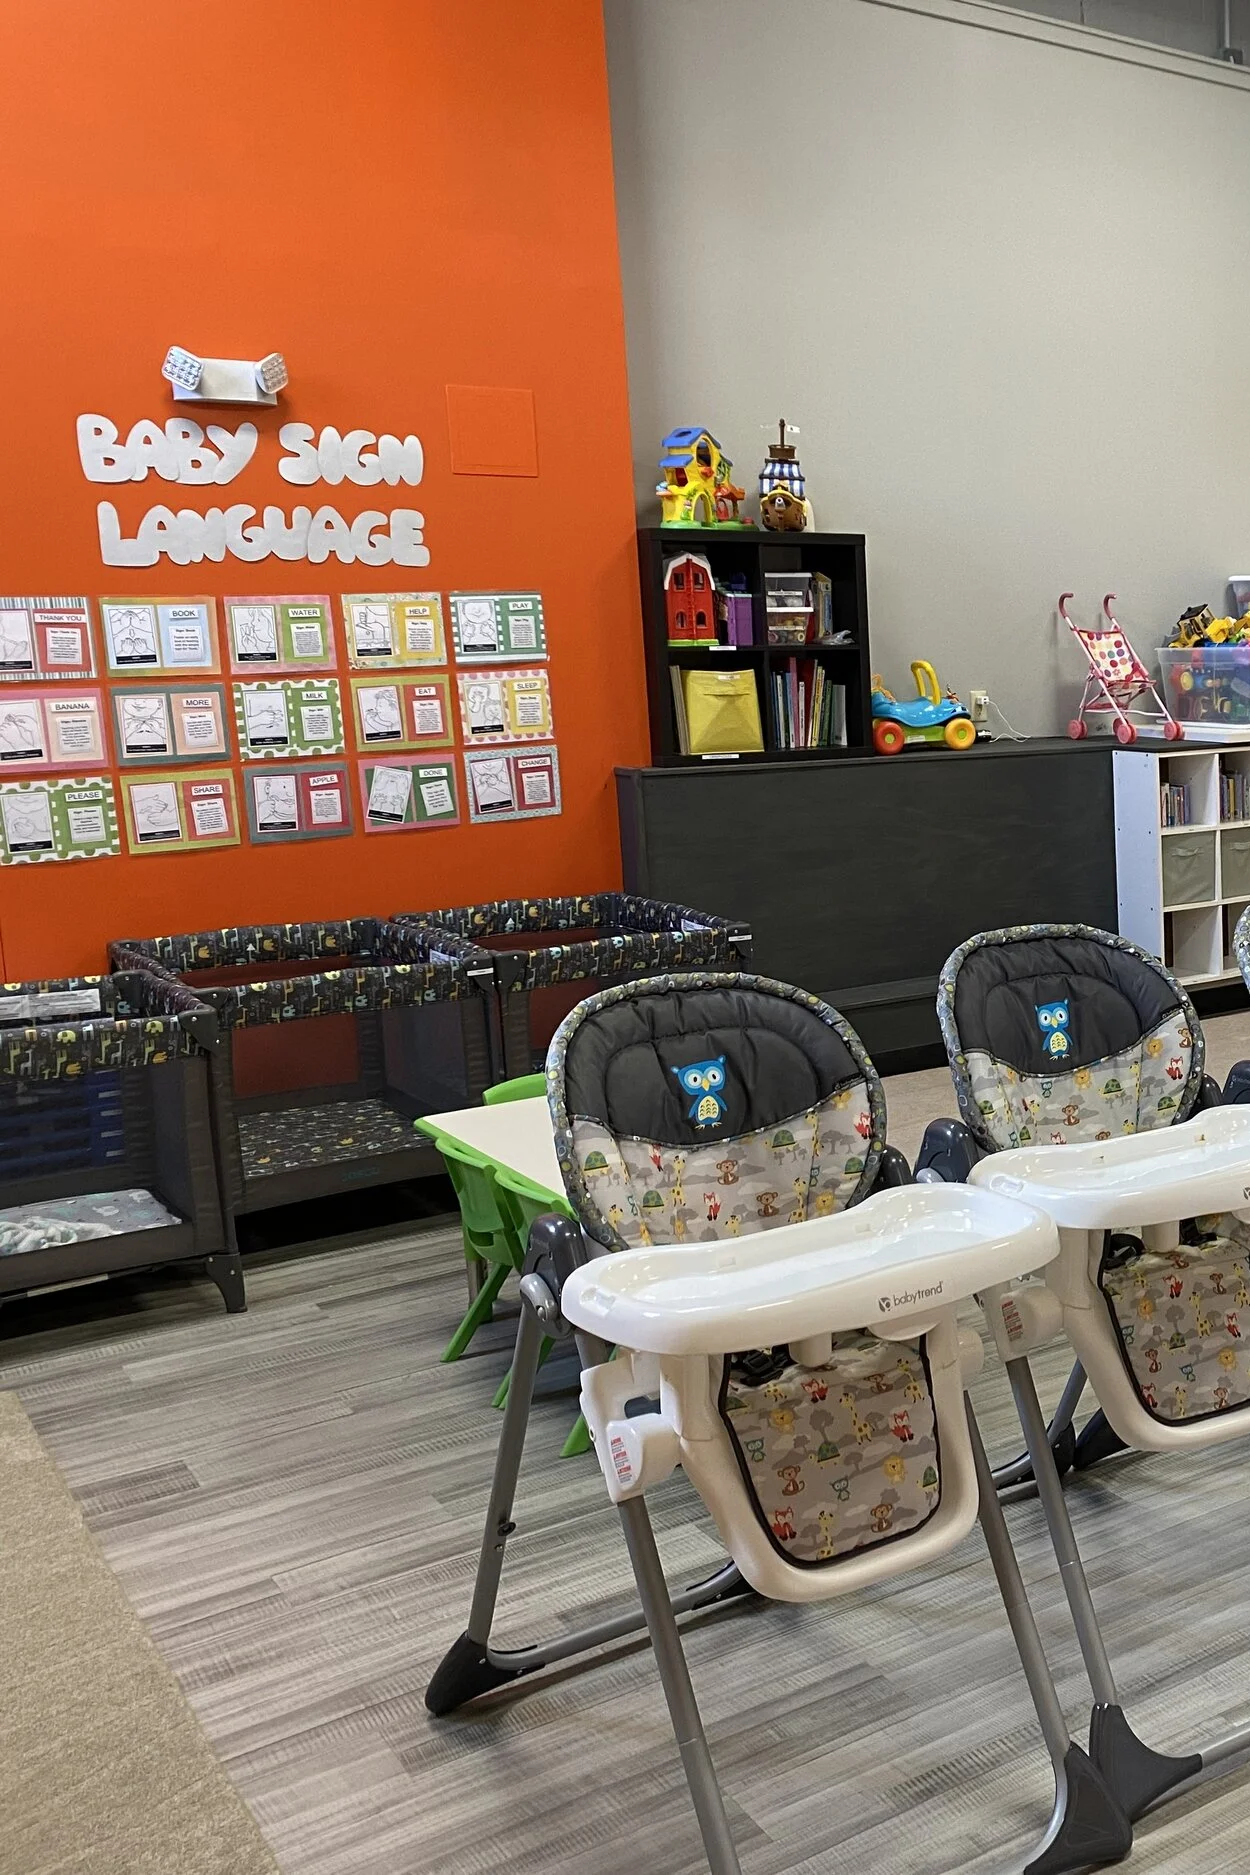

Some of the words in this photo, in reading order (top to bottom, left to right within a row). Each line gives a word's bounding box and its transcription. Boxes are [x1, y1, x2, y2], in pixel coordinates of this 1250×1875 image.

[76, 413, 258, 485] BABY
[277, 422, 424, 486] SIGN
[97, 501, 431, 567] LANGUAGE
[172, 609, 196, 617] BOOK
[409, 607, 428, 615] HELP
[305, 692, 323, 700] MILK
[55, 702, 90, 711] BANANA
[312, 775, 335, 784] APPLE
[193, 786, 221, 794] SHARE
[67, 791, 100, 800] PLEASE
[893, 1281, 944, 1306] babytrend
